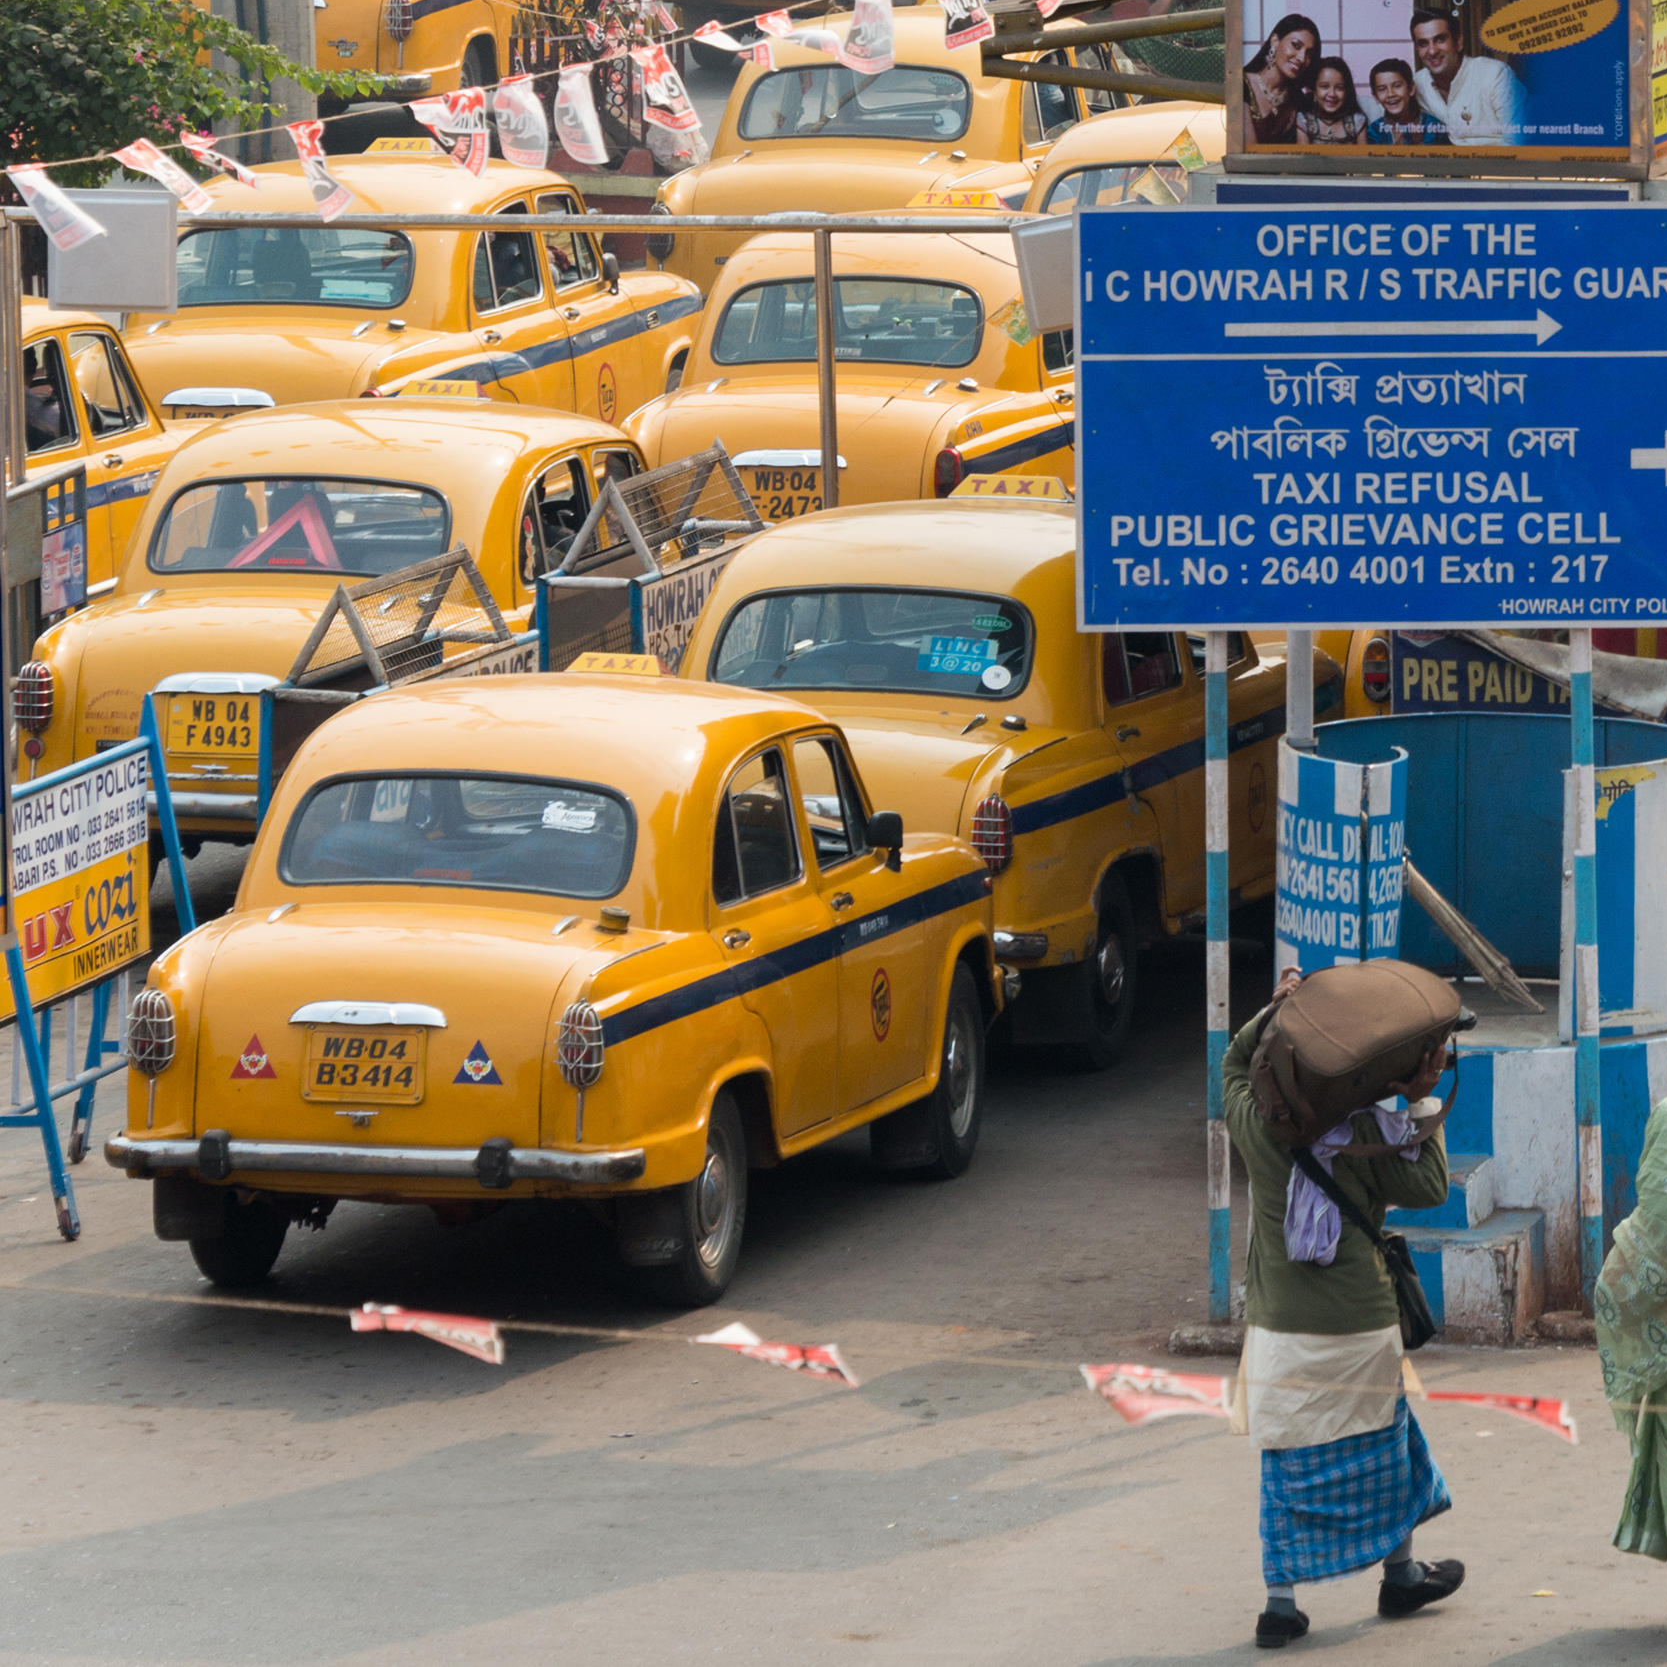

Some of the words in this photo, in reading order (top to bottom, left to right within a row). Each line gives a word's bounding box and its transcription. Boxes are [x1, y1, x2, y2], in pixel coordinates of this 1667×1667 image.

[1257, 223, 1393, 258] OFFICE
[1401, 223, 1453, 257] OF
[1461, 222, 1537, 256] THE
[1105, 270, 1131, 303] C
[1143, 269, 1313, 302] HOWRAH
[1324, 269, 1351, 301] R
[1378, 268, 1401, 301] S
[1412, 267, 1562, 300] TRAFFIC
[1210, 415, 1350, 461] পাবলিক
[1508, 426, 1580, 458] সেল
[970, 478, 1052, 495] TAXI
[1254, 473, 1341, 506] TAXI
[1355, 471, 1542, 505] REFUSAL
[1110, 513, 1256, 549] PUBLIC
[1270, 511, 1504, 546] GRIEVANCE
[1517, 511, 1621, 545] CELL
[1113, 556, 1170, 587] Tel.
[1182, 555, 1230, 587] No
[1262, 555, 1339, 585] 2640
[1349, 554, 1425, 585] 4001
[1440, 554, 1515, 585] Extn
[1551, 554, 1609, 584] 217
[1501, 597, 1585, 615] HOWRAH
[1589, 597, 1631, 615] CITY
[1402, 657, 1459, 703] PRE
[1467, 661, 1533, 705] PAID
[192, 700, 216, 723] WB
[226, 700, 250, 724] 04
[202, 725, 251, 749] 4943
[95, 756, 146, 802] POLICE
[73, 927, 138, 980] INNERWEAR
